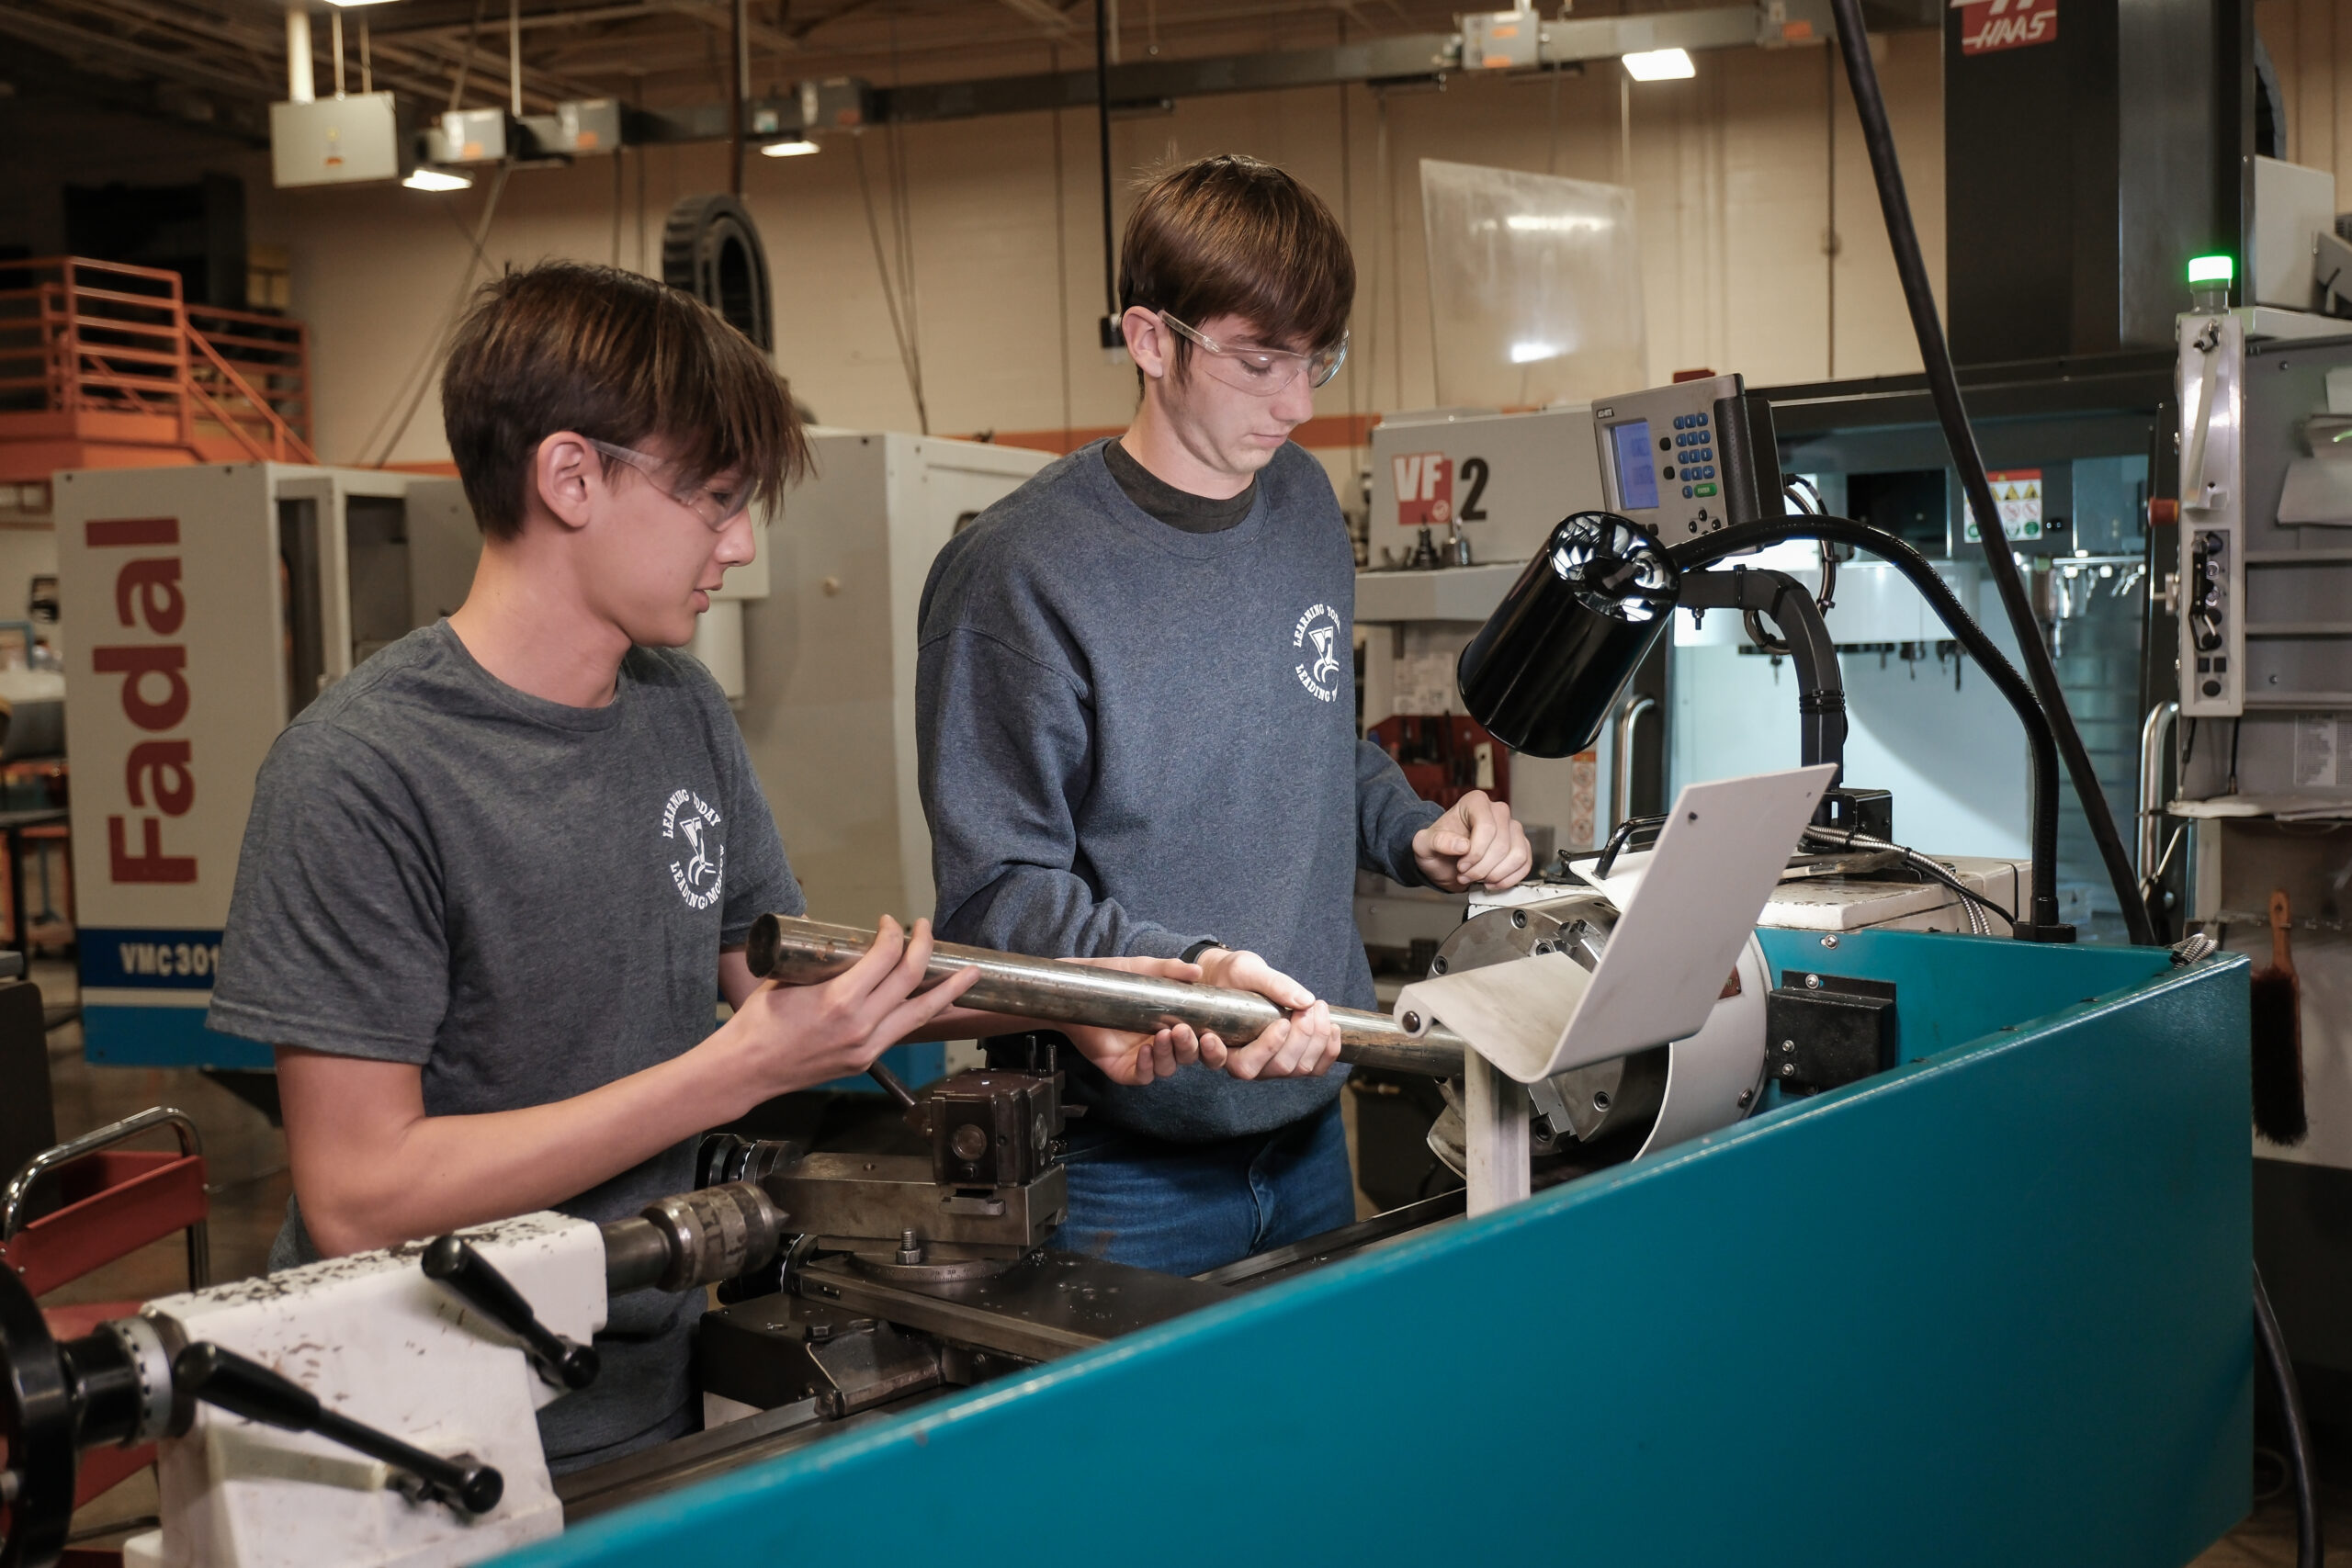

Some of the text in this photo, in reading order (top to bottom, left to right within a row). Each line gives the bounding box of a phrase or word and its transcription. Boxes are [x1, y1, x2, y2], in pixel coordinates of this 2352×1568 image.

[1961, 9, 2057, 49] HAAS
[1392, 453, 1489, 522] VF 2
[1293, 604, 1340, 648] LEARNING TOD
[85, 517, 198, 884] Fadal
[1295, 663, 1330, 703] LEADING
[670, 860, 706, 909] LEADING
